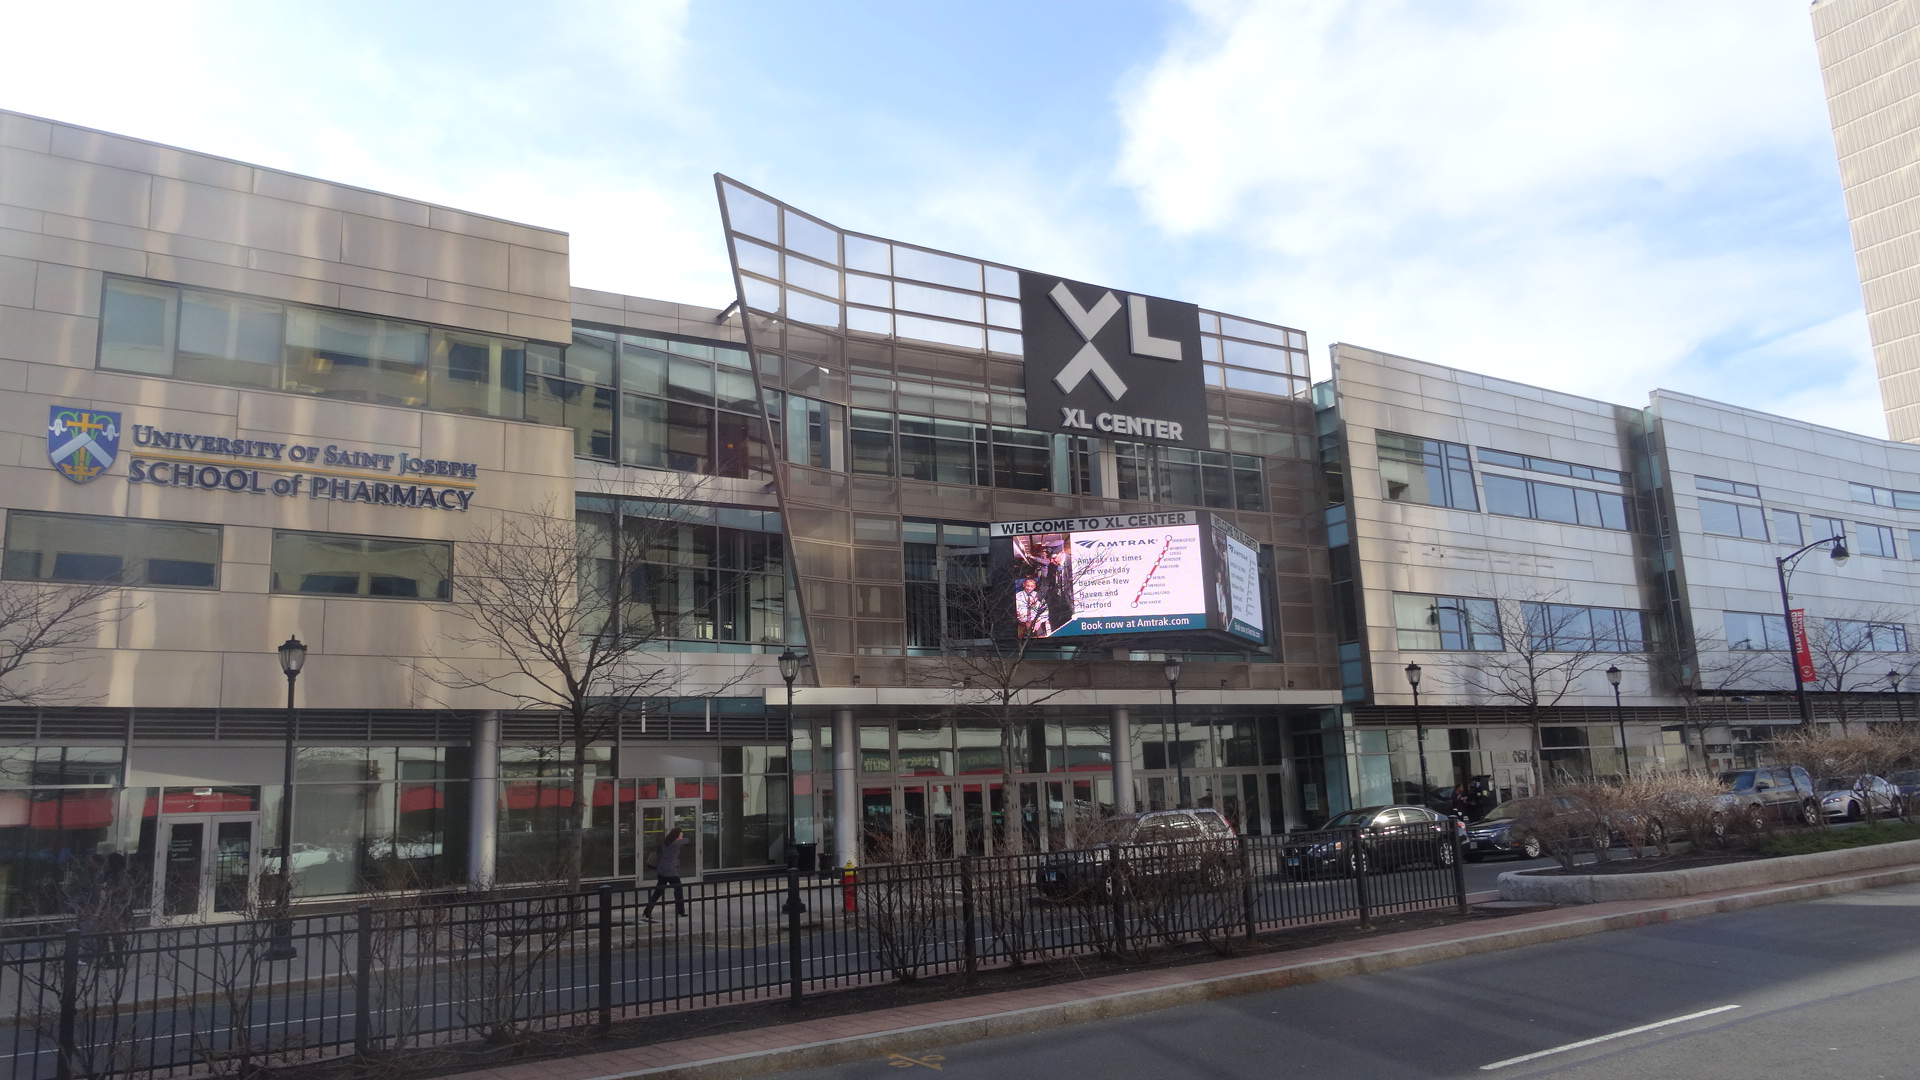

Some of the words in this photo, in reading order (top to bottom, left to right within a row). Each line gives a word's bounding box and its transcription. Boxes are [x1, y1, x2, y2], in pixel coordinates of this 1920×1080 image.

[1048, 281, 1182, 402] XL
[1061, 407, 1093, 429] XL
[1095, 412, 1183, 441] CENTER
[132, 423, 287, 461] UNIVERSITY
[288, 444, 319, 463] OF
[324, 444, 394, 468] SAINT
[397, 452, 478, 479] JOSEPH
[128, 459, 267, 495] SCHOOL
[272, 474, 303, 497] of
[310, 476, 475, 512] PHARMACY
[1001, 520, 1075, 535] WELCOME
[1078, 518, 1100, 530] TO
[1105, 517, 1124, 528] XL
[1127, 512, 1186, 527] CENTER
[1097, 538, 1155, 548] AMTRAK
[1097, 567, 1130, 575] weekday
[1080, 601, 1112, 609] Hartford
[1081, 620, 1103, 631] Book
[1105, 621, 1124, 630] now
[1126, 619, 1136, 628] at
[1137, 616, 1190, 628] Amtrak.com
[1791, 611, 1803, 653] HARTFORD
